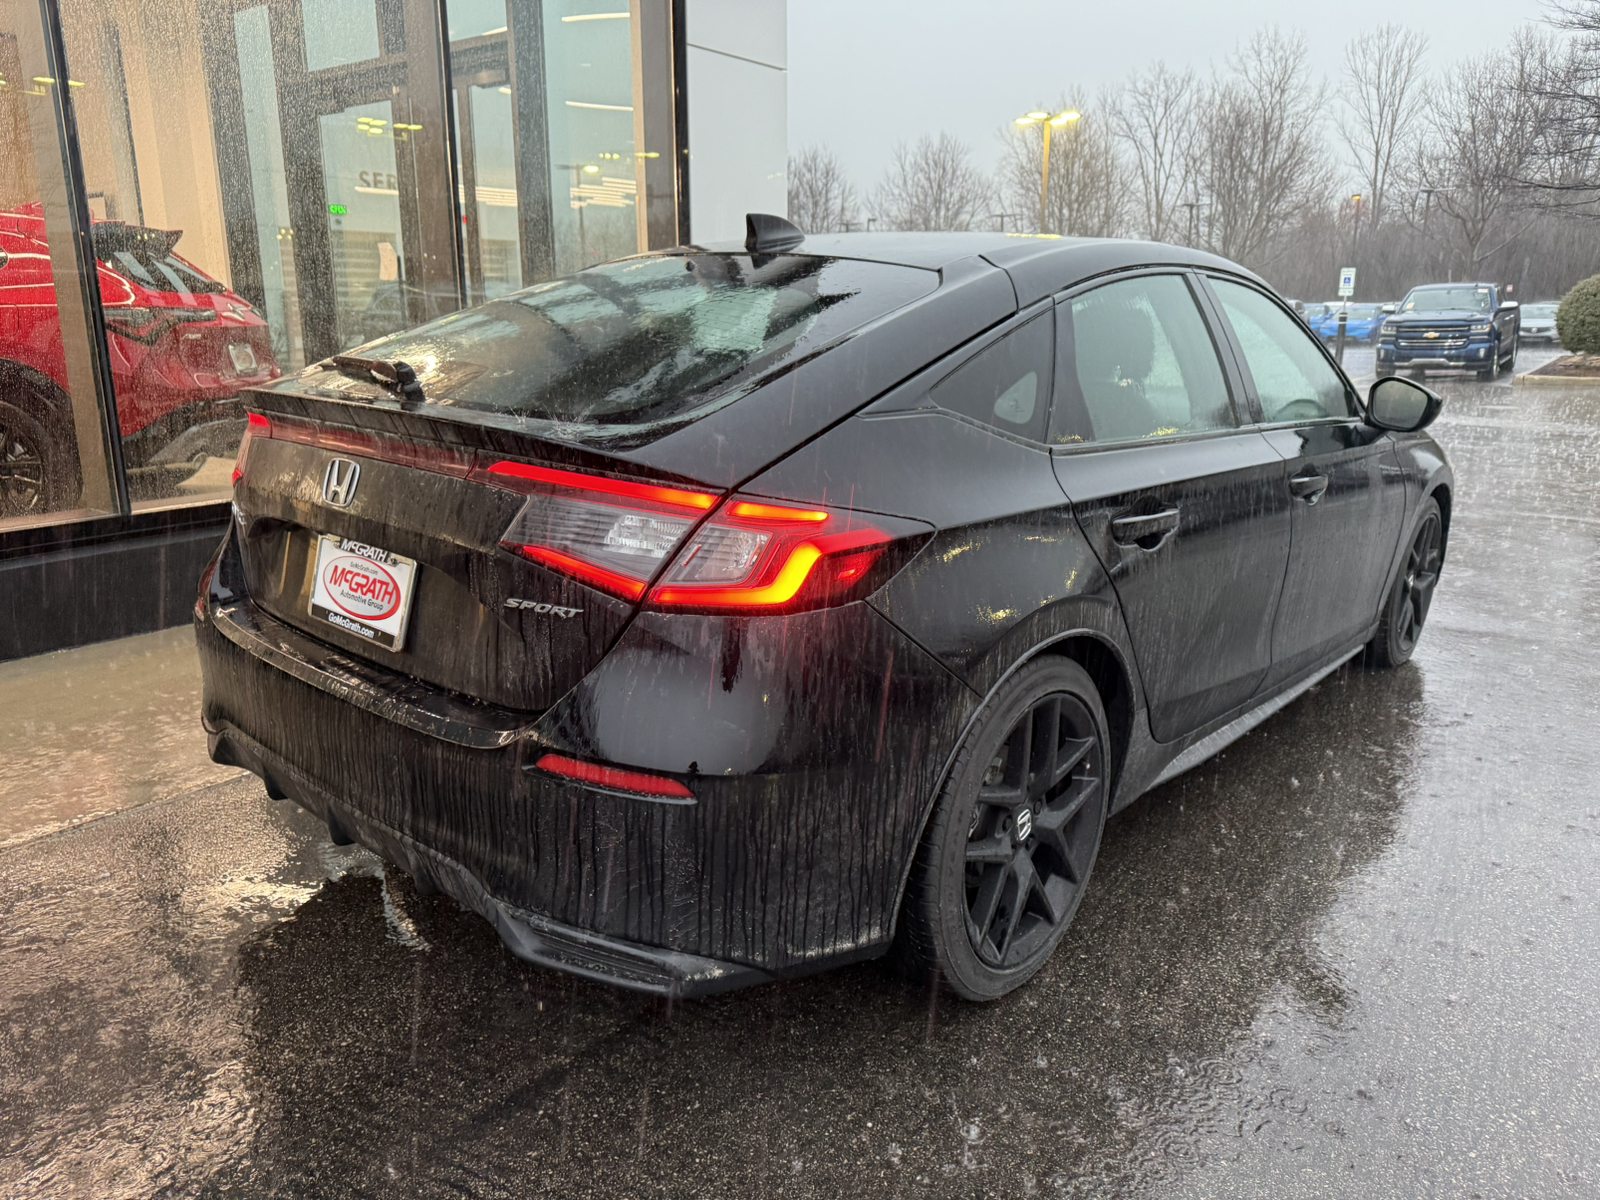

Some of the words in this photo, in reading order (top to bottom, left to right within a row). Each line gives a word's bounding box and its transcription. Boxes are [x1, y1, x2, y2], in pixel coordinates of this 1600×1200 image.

[350, 561, 378, 575] GoMcGrath.com
[340, 589, 367, 605] Automotive
[367, 598, 384, 611] Group
[503, 598, 584, 618] SPORT
[328, 612, 375, 639] GoMcGrath.com
